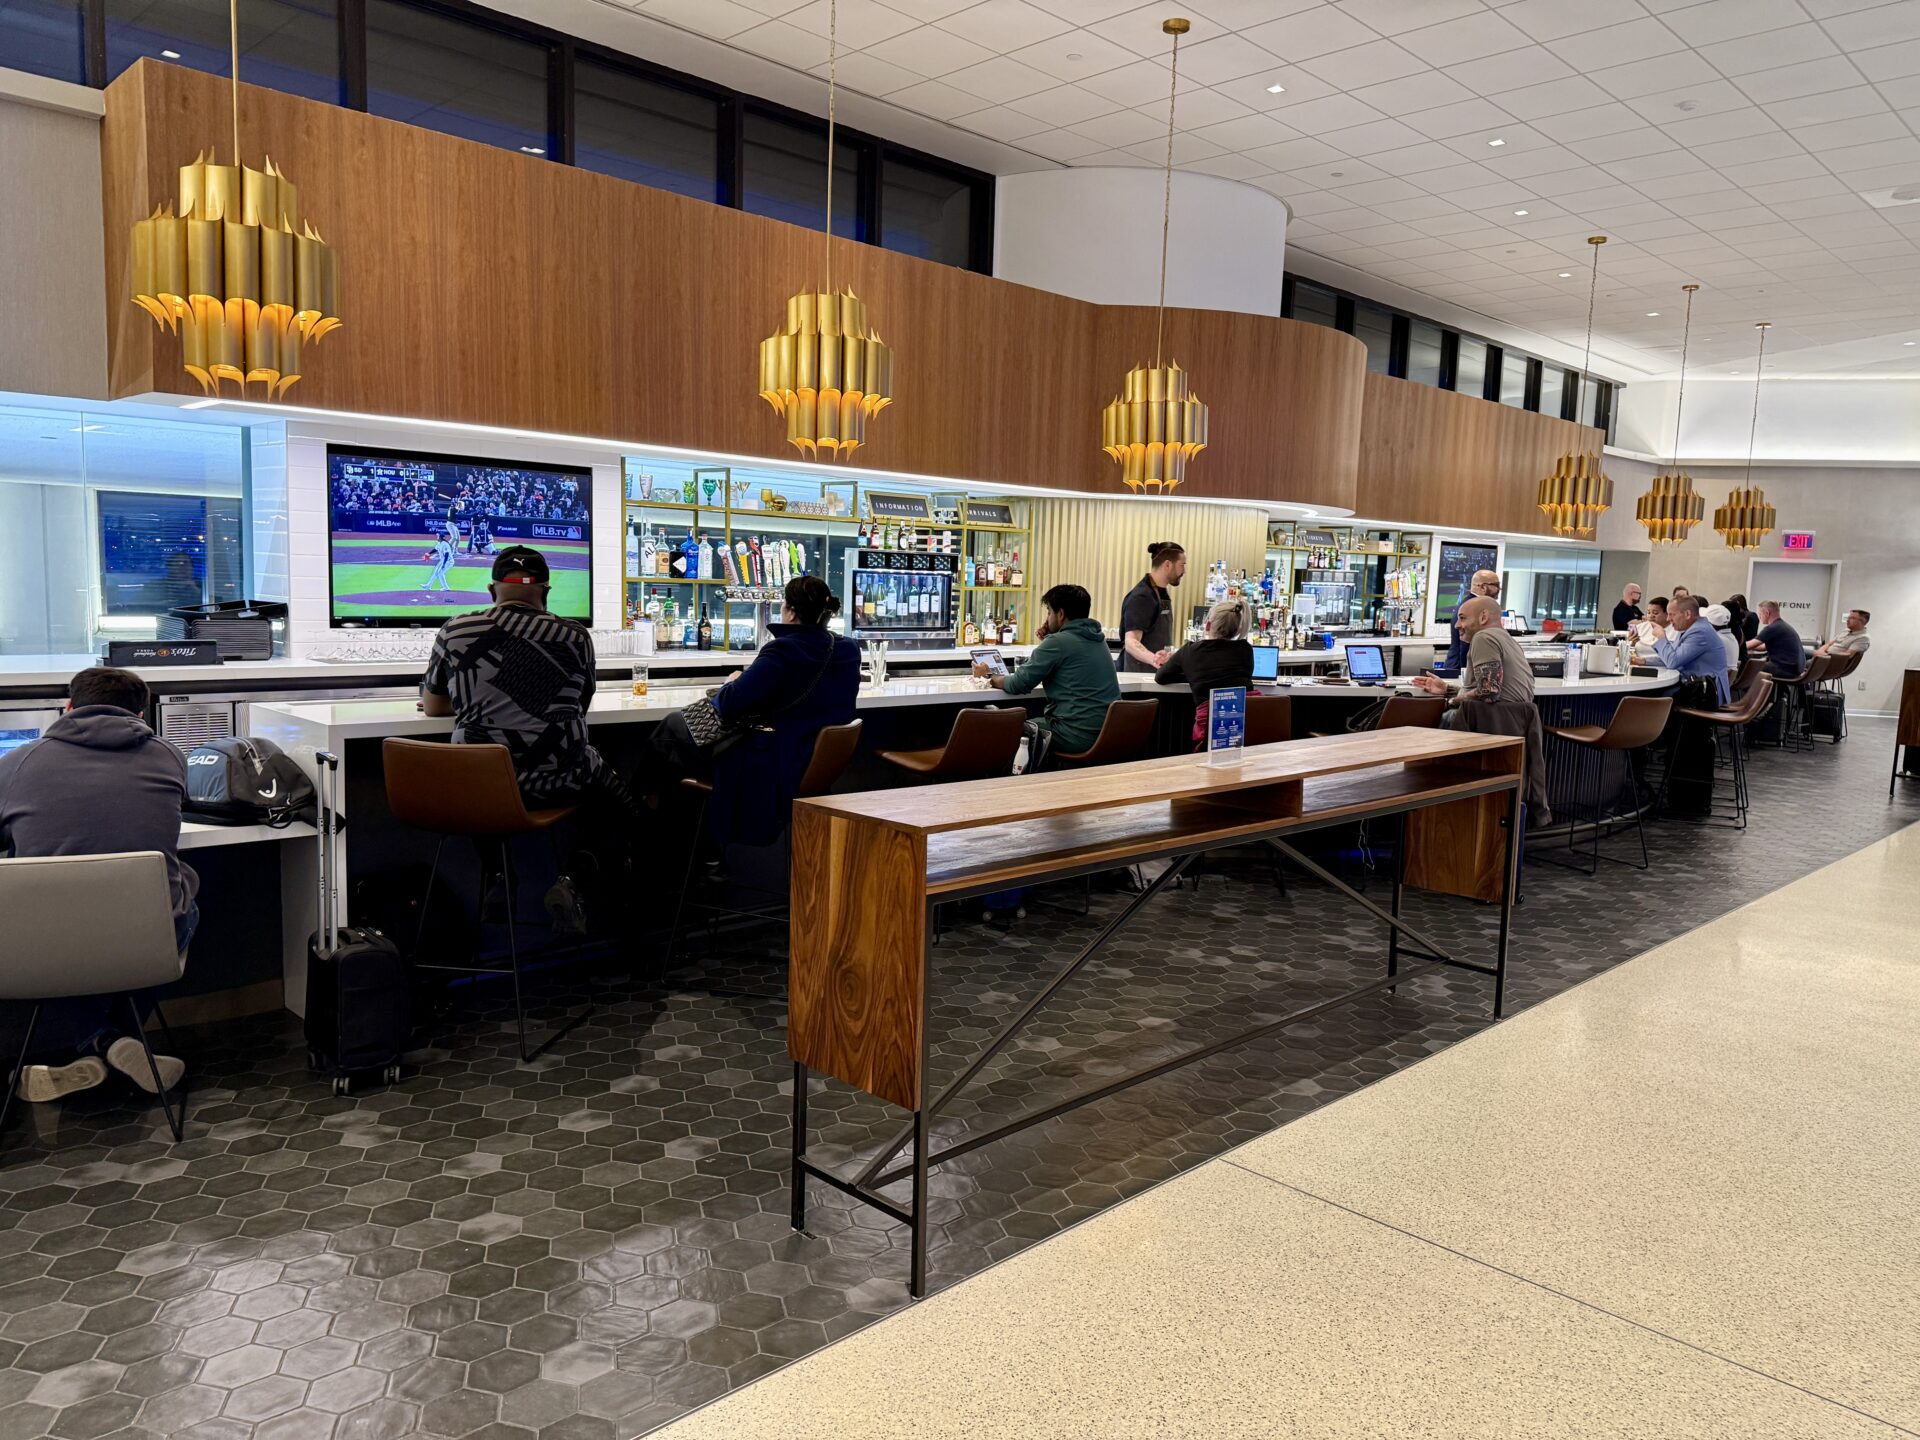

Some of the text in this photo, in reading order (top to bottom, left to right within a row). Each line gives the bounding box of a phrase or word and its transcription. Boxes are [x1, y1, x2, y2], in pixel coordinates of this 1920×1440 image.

[875, 502, 924, 512] INFORMATION
[1789, 535, 1809, 548] EXIT
[170, 647, 197, 657] Tito's
[187, 755, 219, 766] EAD
